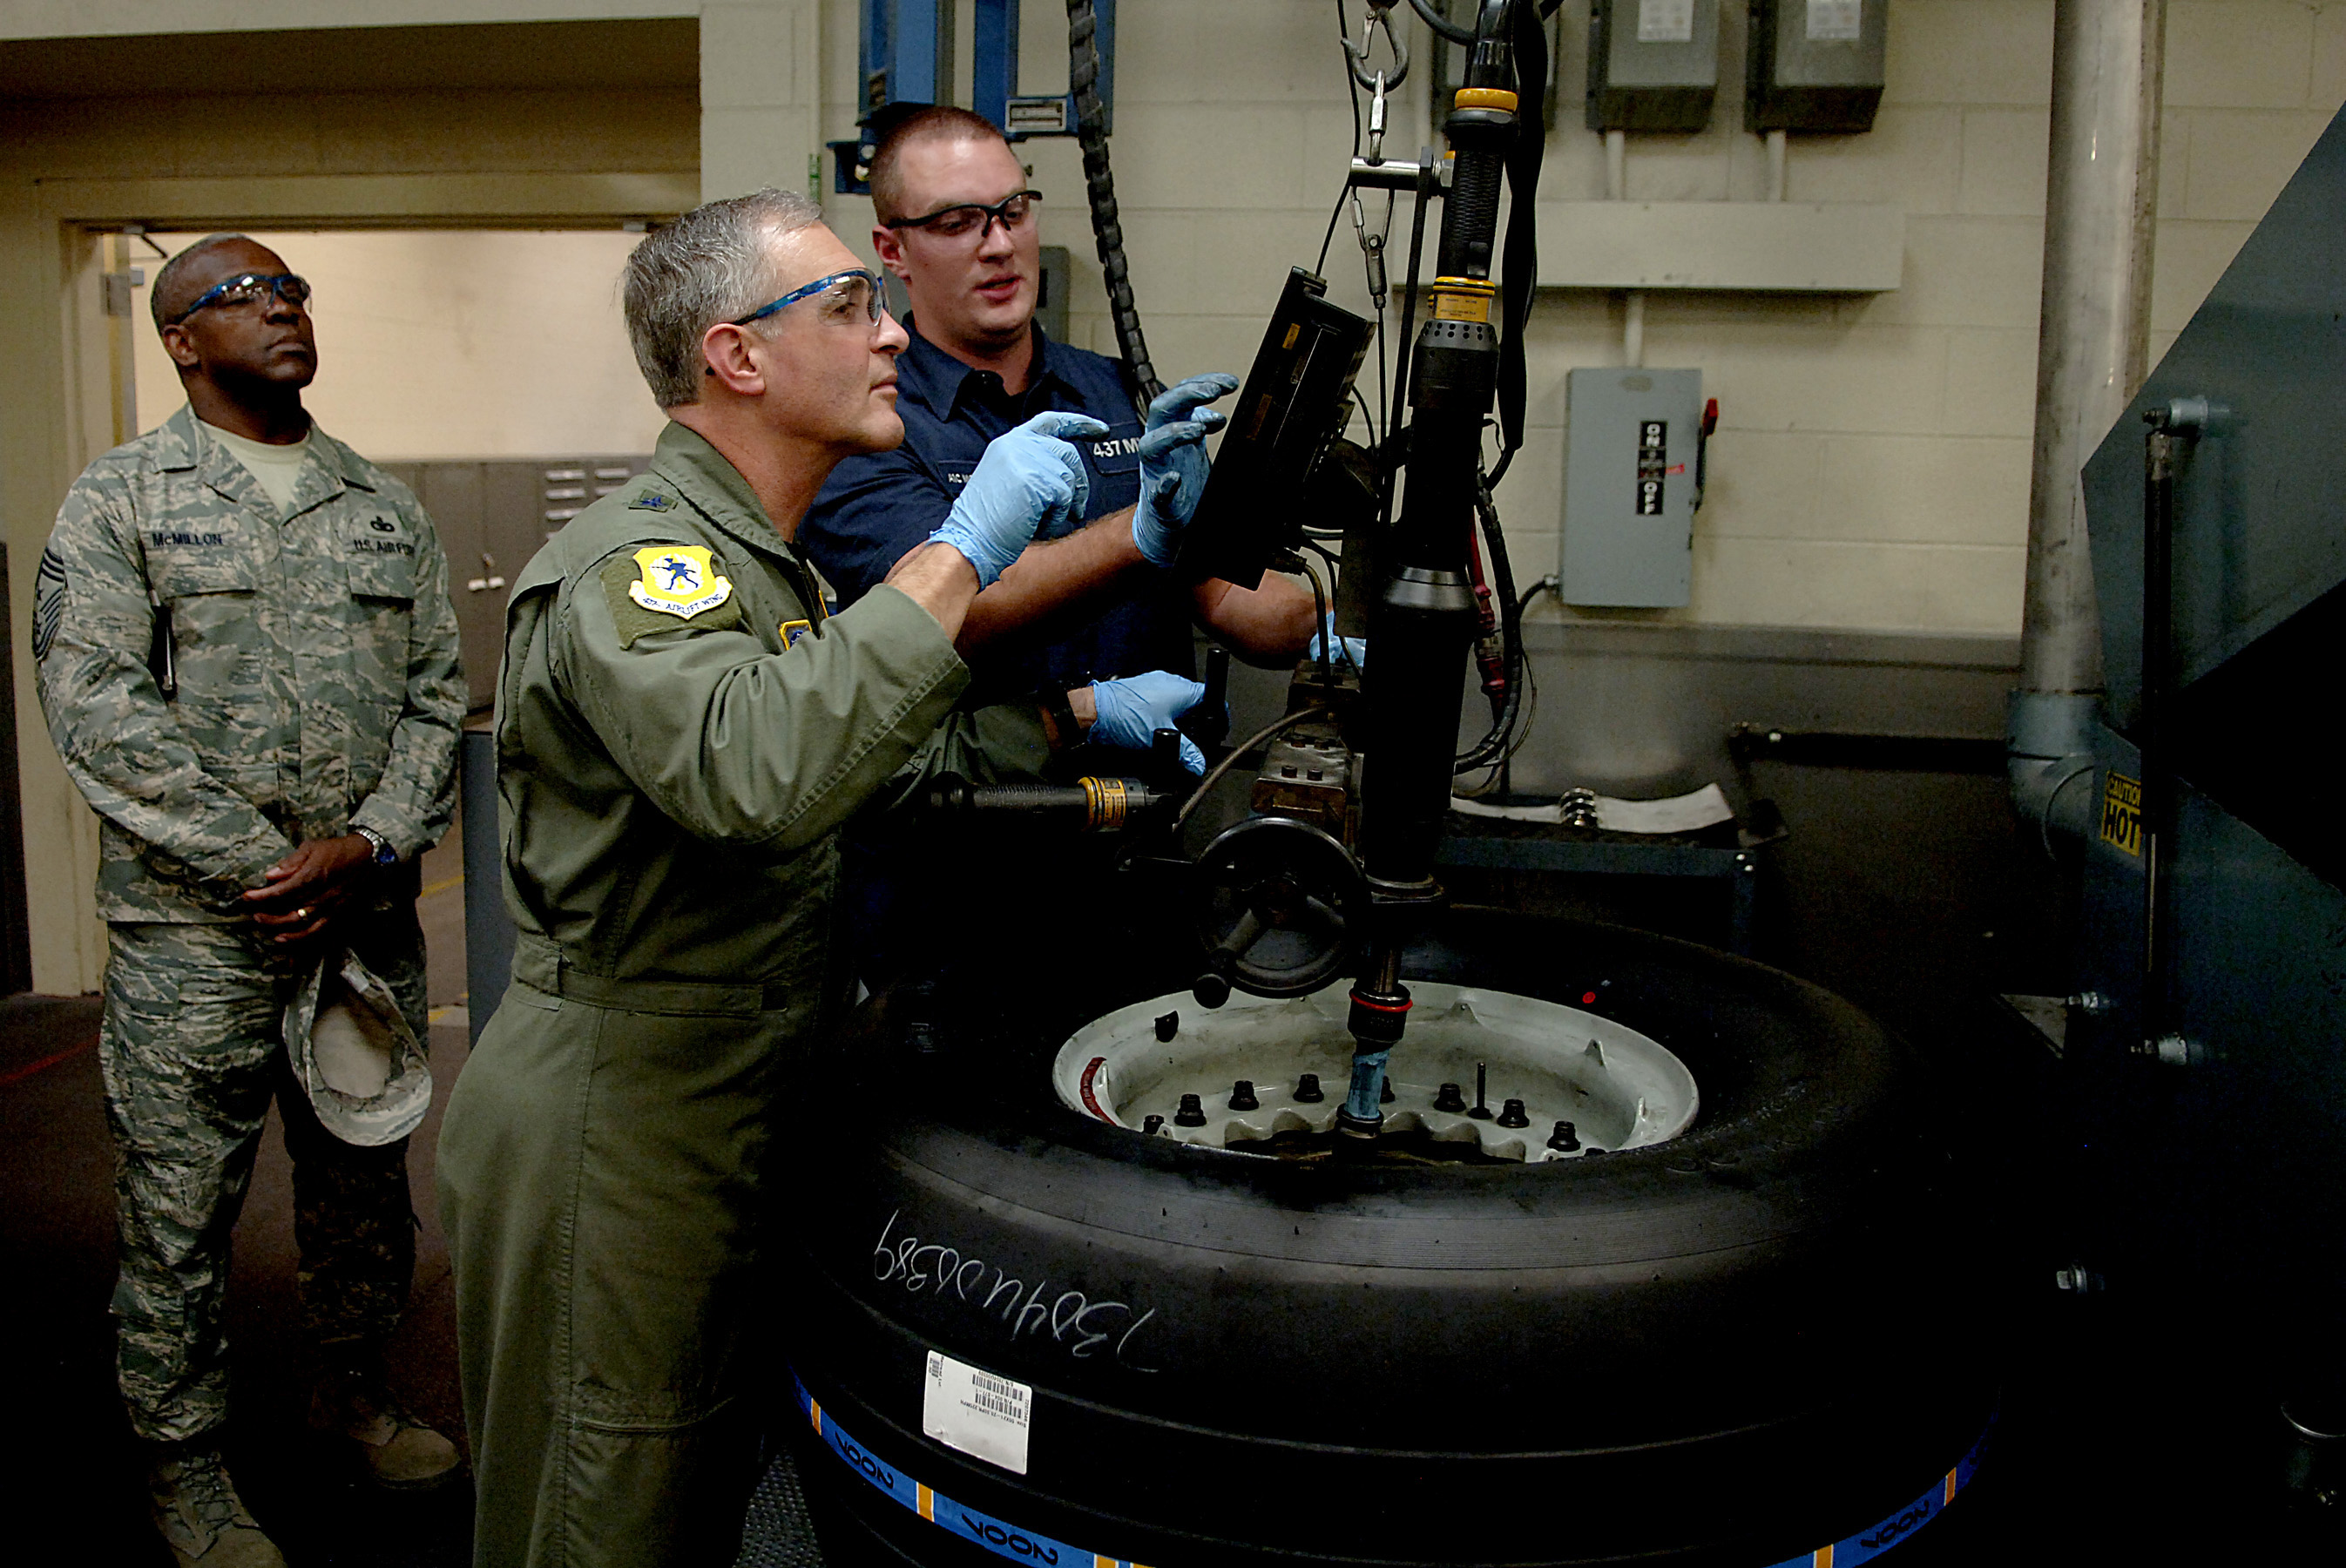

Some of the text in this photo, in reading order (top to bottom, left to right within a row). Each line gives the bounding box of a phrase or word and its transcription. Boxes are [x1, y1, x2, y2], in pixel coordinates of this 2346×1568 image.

[1646, 423, 1660, 447] ON
[1093, 437, 1140, 457] 437 M
[1644, 481, 1658, 515] OFF
[152, 532, 223, 547] McMILLON
[666, 603, 700, 615] AIRLIFT
[701, 593, 723, 605] WING
[2104, 801, 2141, 848] HOT
